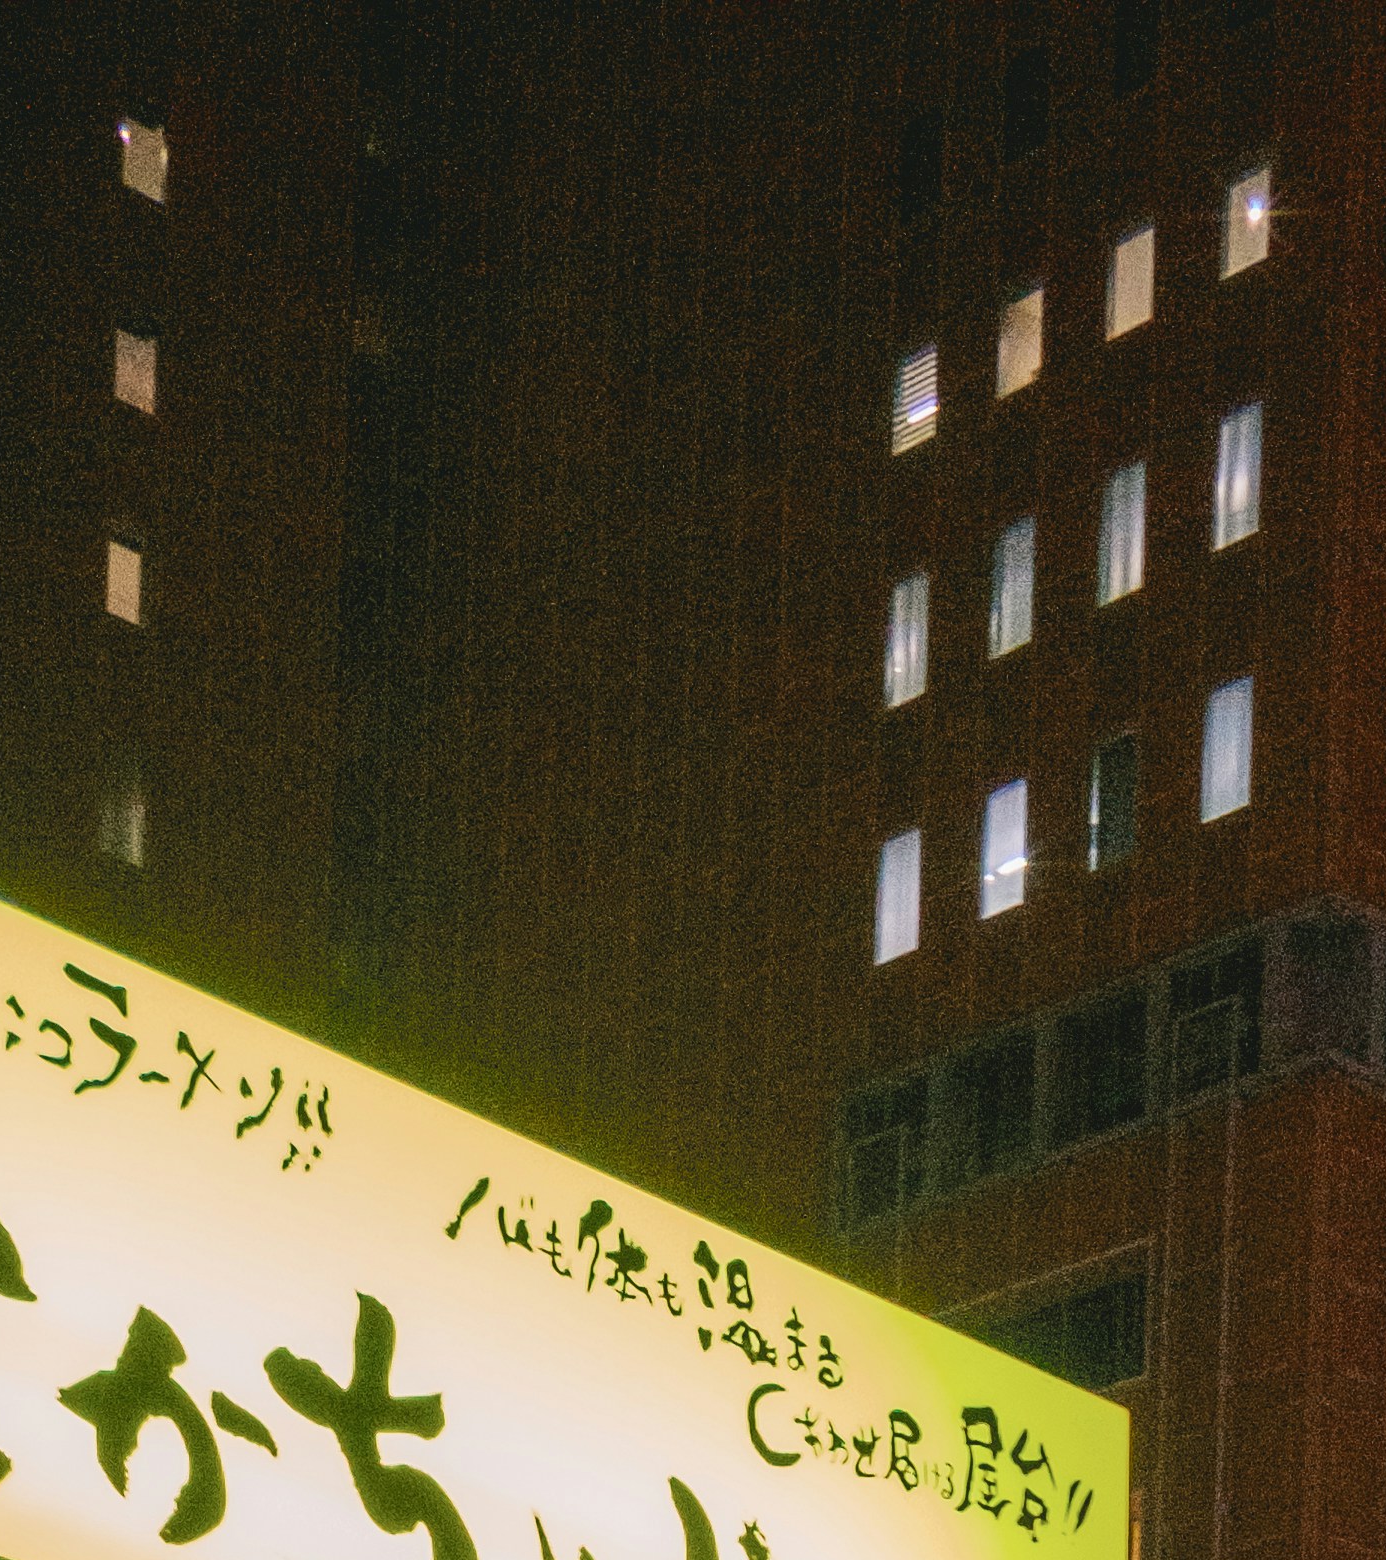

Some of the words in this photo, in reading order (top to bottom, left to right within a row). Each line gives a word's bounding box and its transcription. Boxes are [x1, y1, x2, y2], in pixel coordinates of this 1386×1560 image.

[445, 1178, 845, 1388] 心も体も温まる
